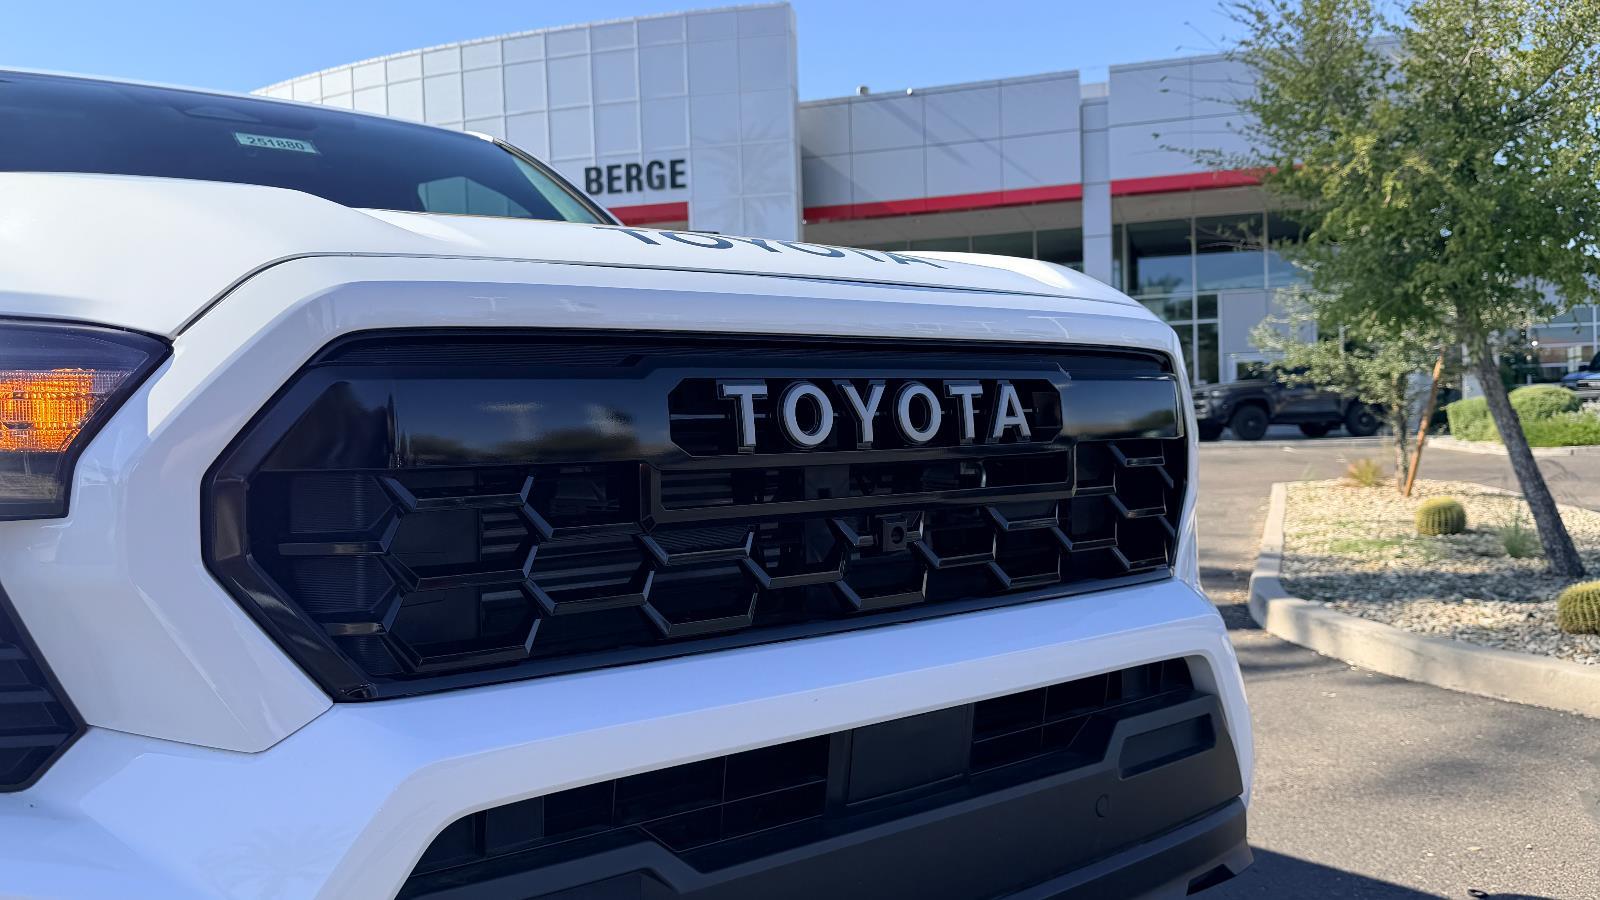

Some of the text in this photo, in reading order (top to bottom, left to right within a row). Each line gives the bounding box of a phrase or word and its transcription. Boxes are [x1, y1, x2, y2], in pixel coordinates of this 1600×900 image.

[247, 136, 304, 150] 251880
[585, 159, 686, 195] BERGE
[592, 226, 948, 270] TOYOTA
[719, 381, 1032, 451] TOYOTA
